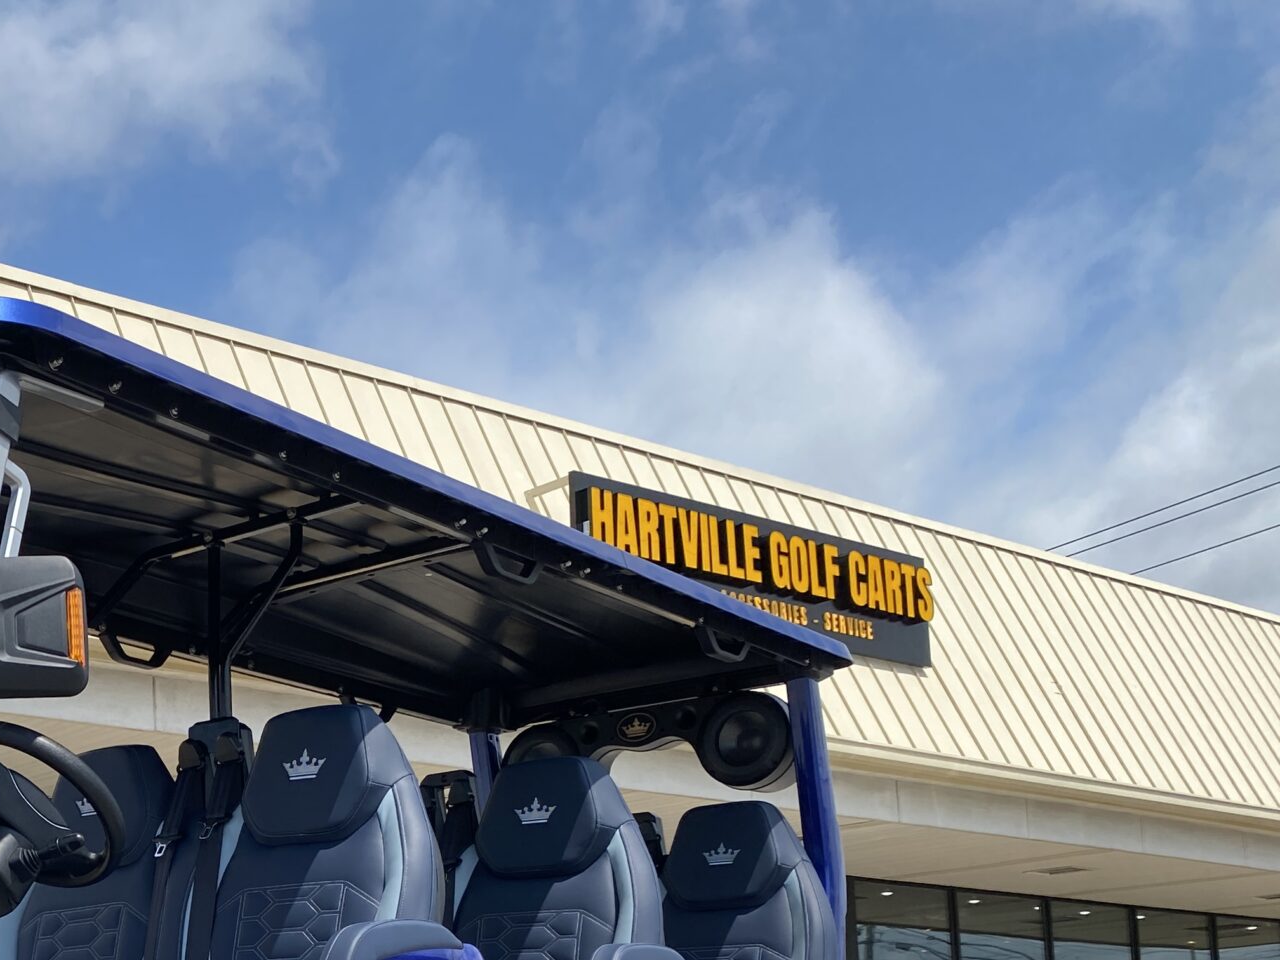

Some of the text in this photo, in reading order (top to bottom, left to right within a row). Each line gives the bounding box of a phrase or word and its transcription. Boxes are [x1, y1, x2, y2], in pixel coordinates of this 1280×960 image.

[590, 486, 934, 621] HARTVILLE GOLF CARTS
[823, 611, 874, 640] SERVICE
